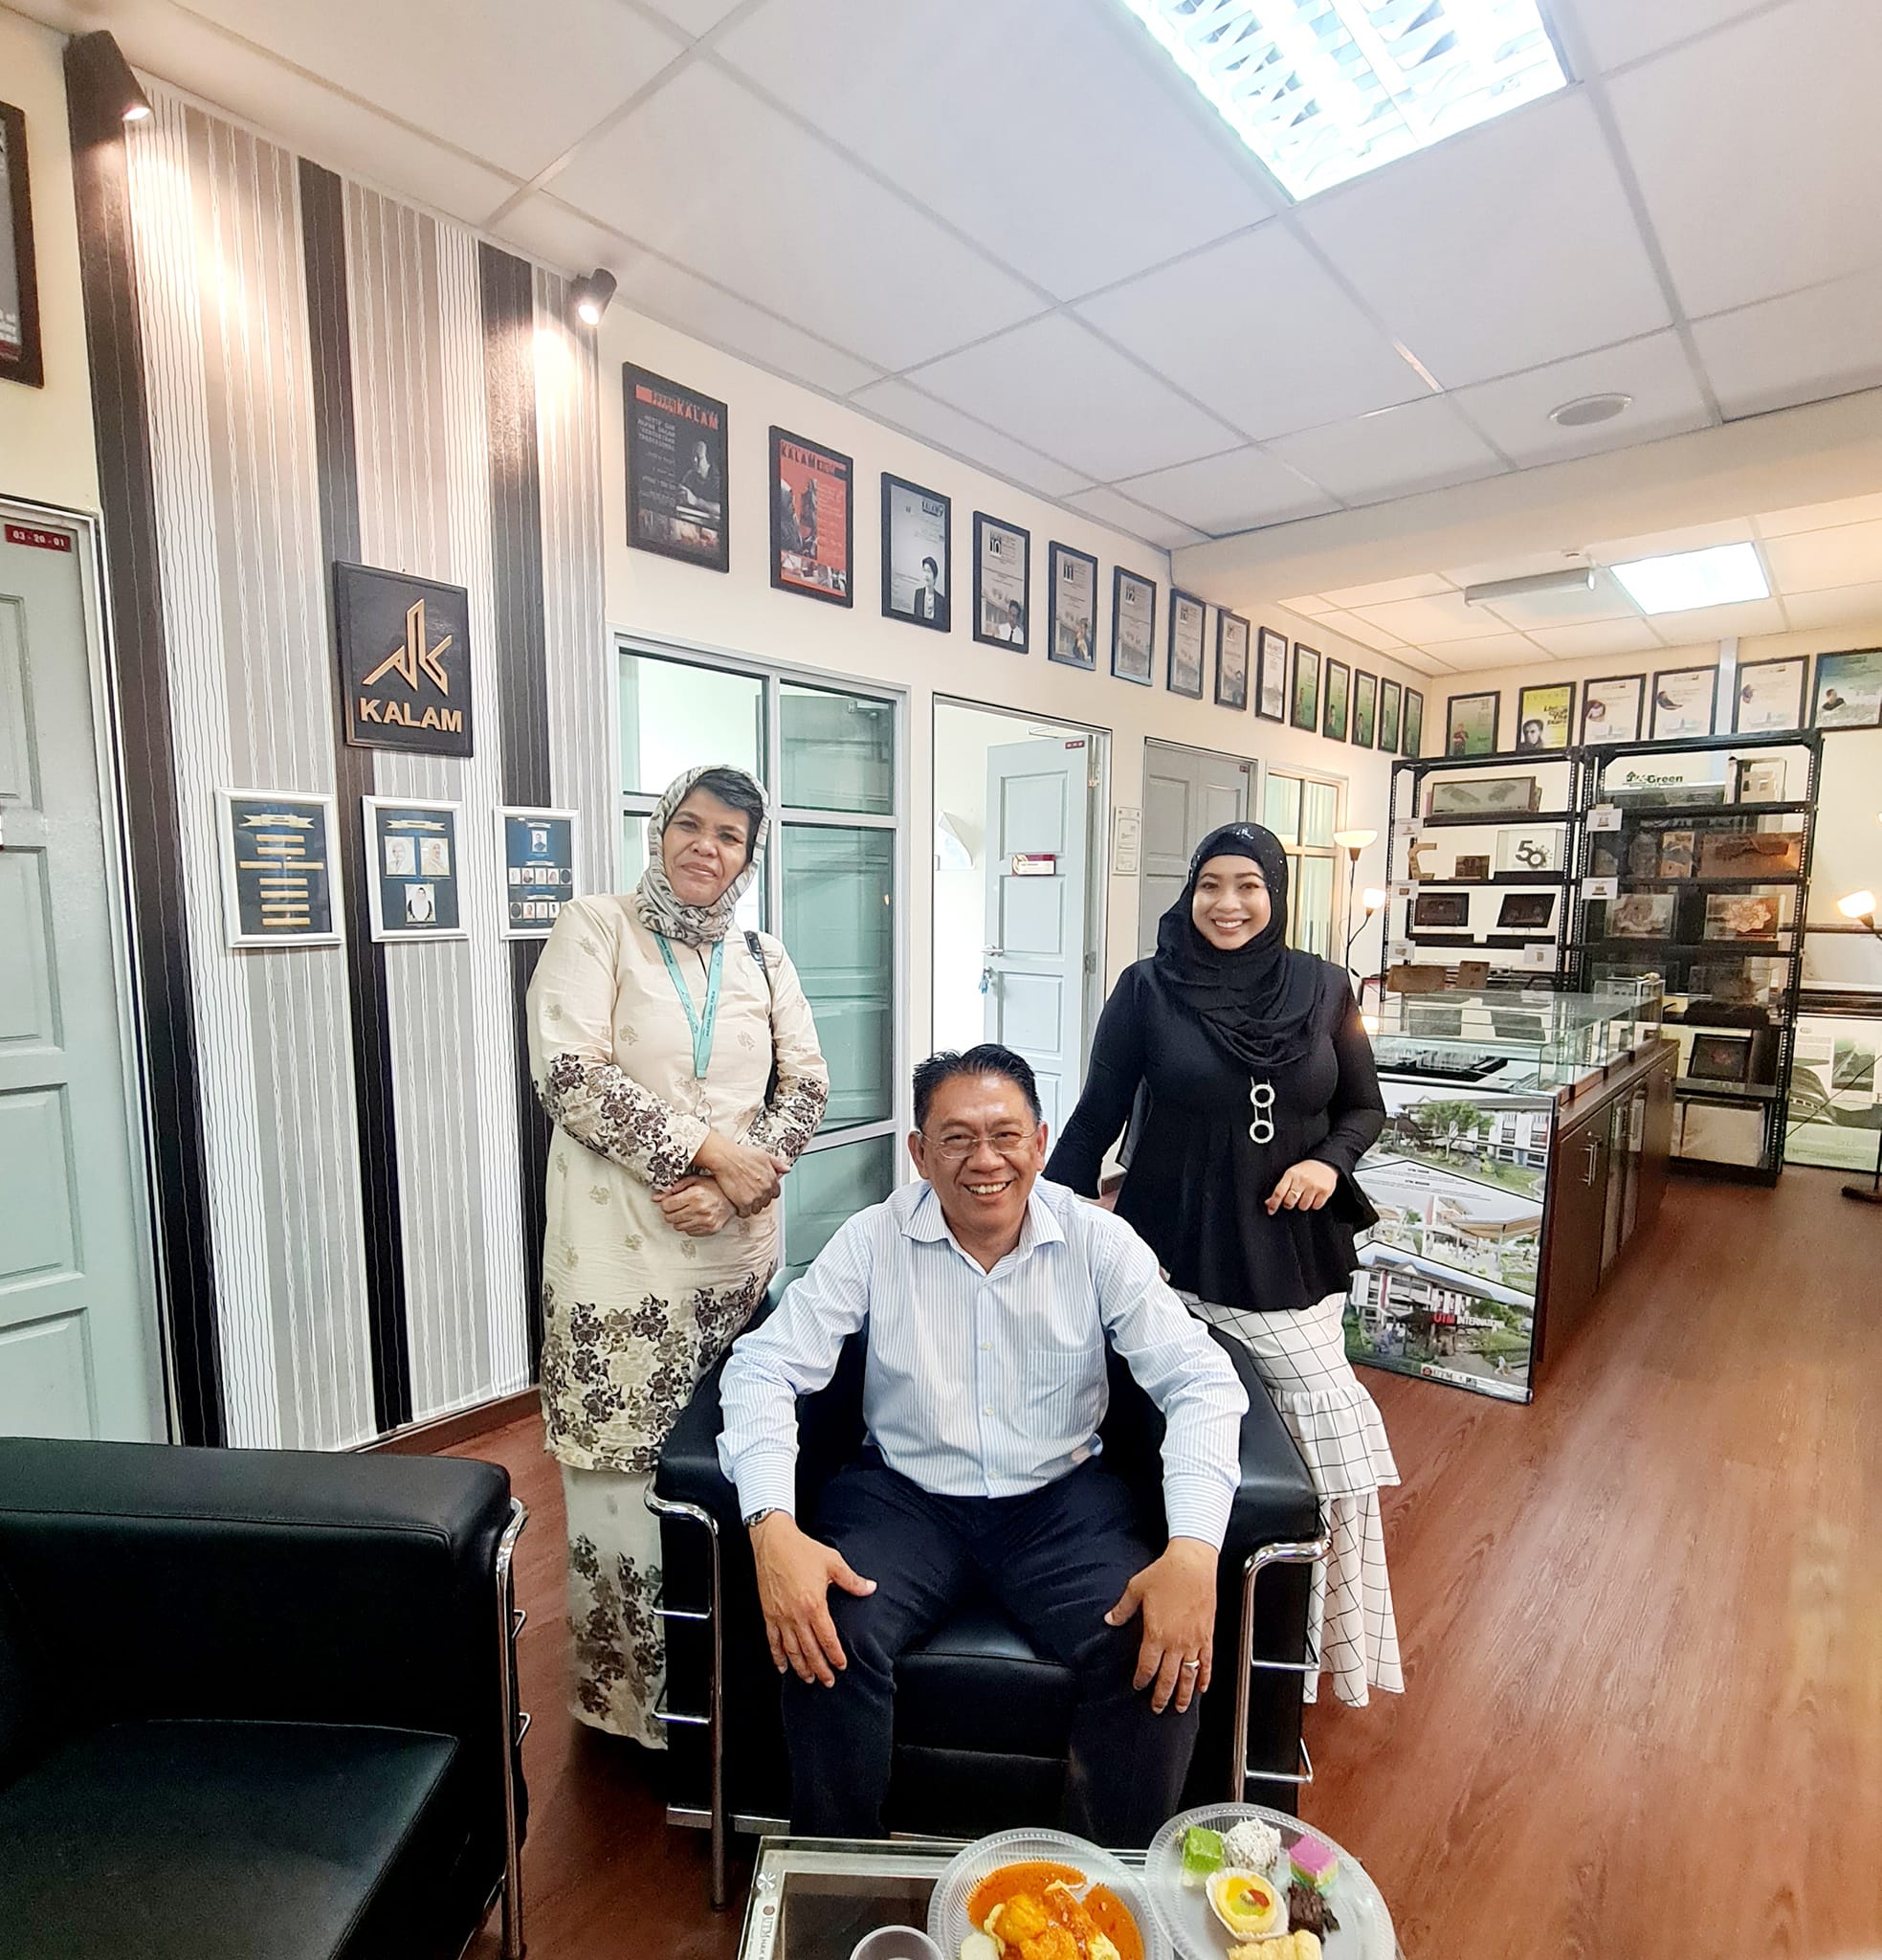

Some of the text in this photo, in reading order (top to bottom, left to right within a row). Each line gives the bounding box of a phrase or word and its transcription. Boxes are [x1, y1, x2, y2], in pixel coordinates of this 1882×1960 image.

[359, 697, 463, 733] KALAM
[1647, 774, 1684, 784] Green
[1433, 1312, 1455, 1325] UTM
